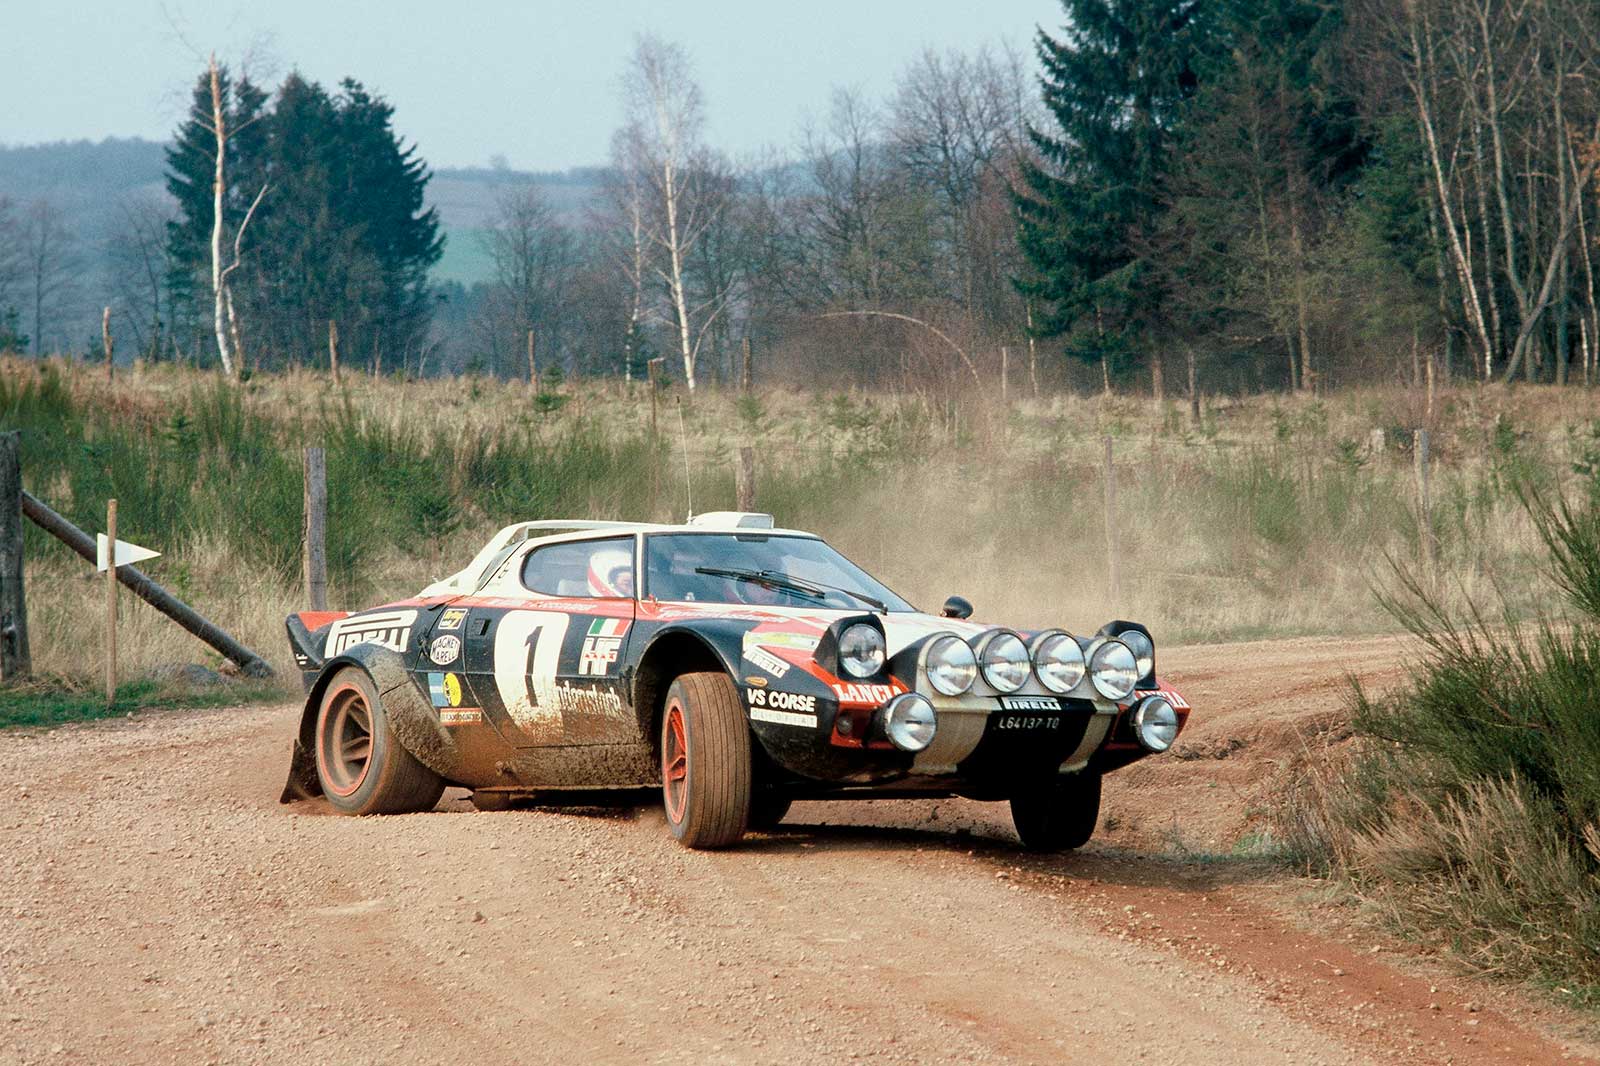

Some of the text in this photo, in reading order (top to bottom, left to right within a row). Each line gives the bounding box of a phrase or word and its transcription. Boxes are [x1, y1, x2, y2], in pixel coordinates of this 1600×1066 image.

[324, 610, 418, 658] PIRELLI
[525, 626, 543, 708] 1
[578, 637, 622, 675] HF
[743, 645, 791, 678] PIRELLI
[747, 688, 816, 712] VS CORSE
[832, 683, 903, 703] LANCIA
[1001, 696, 1062, 711] PIRELLI
